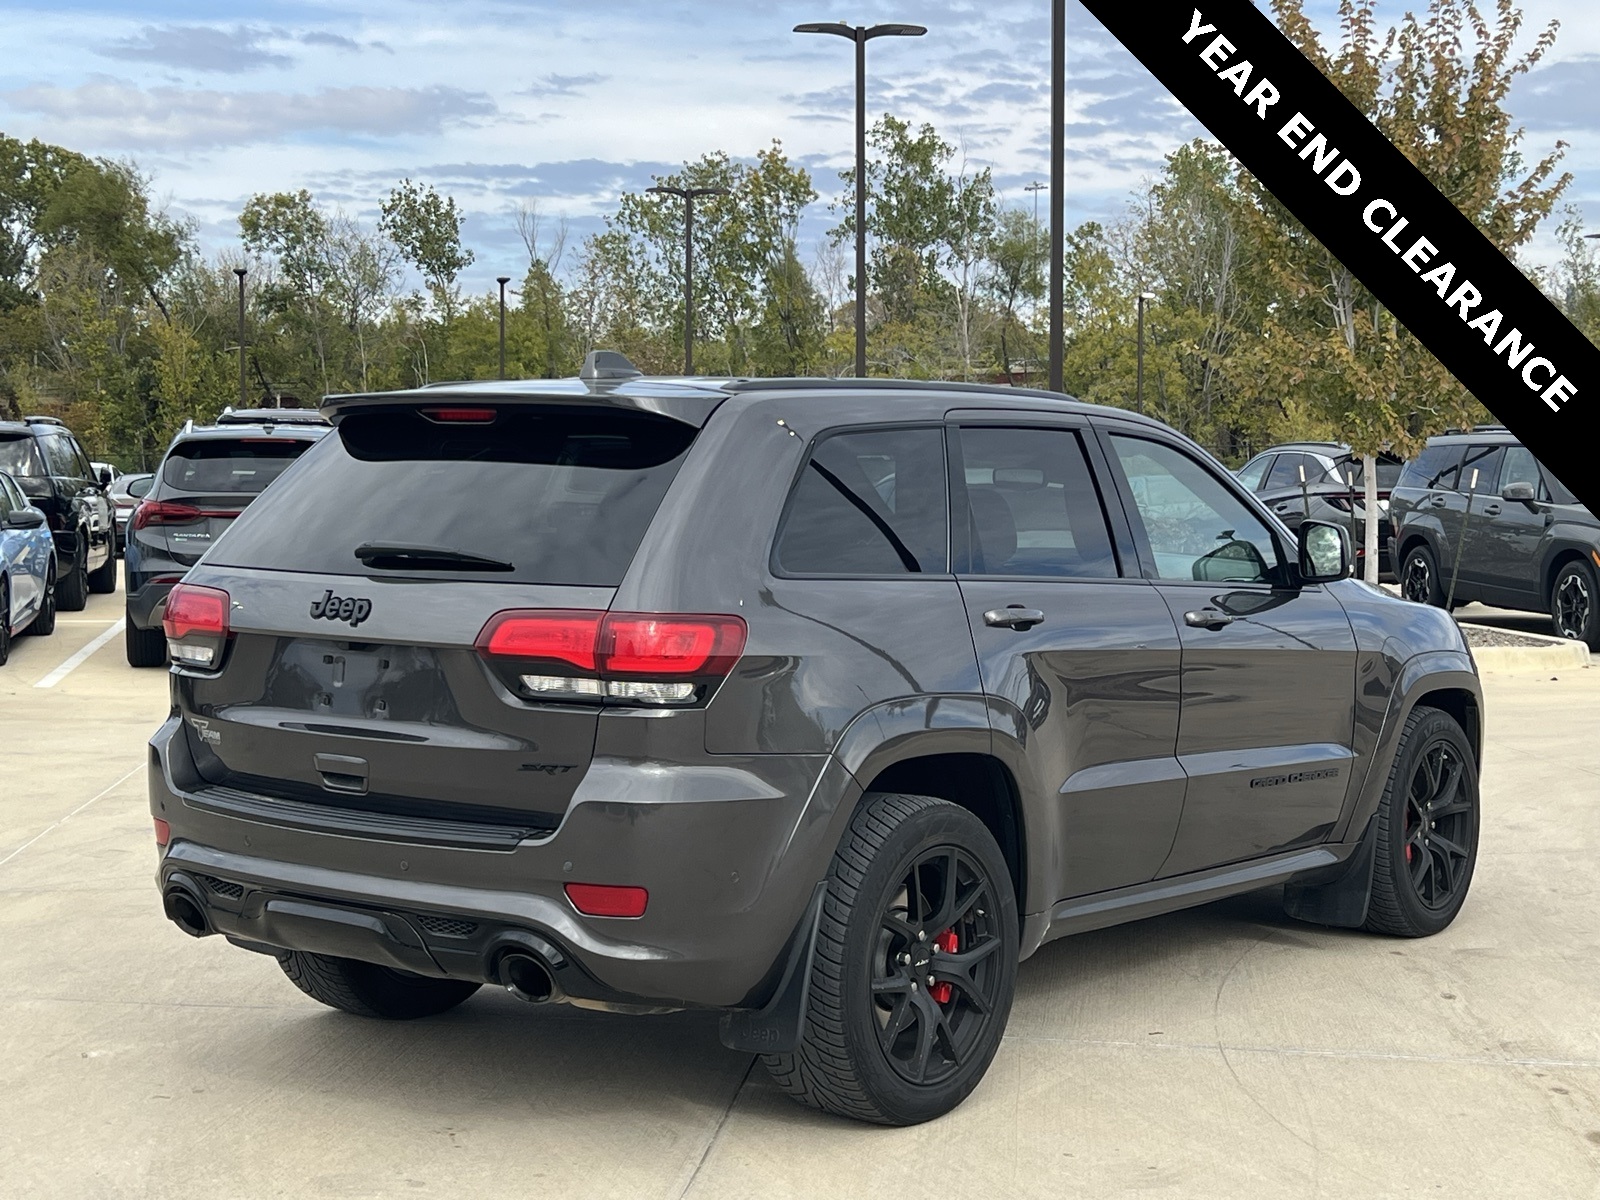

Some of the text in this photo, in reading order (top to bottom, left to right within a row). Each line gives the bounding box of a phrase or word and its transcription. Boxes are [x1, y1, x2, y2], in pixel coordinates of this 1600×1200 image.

[310, 589, 372, 628] Jeep
[517, 763, 579, 775] SRT
[1249, 767, 1339, 788] GRAND CHEROKEE
